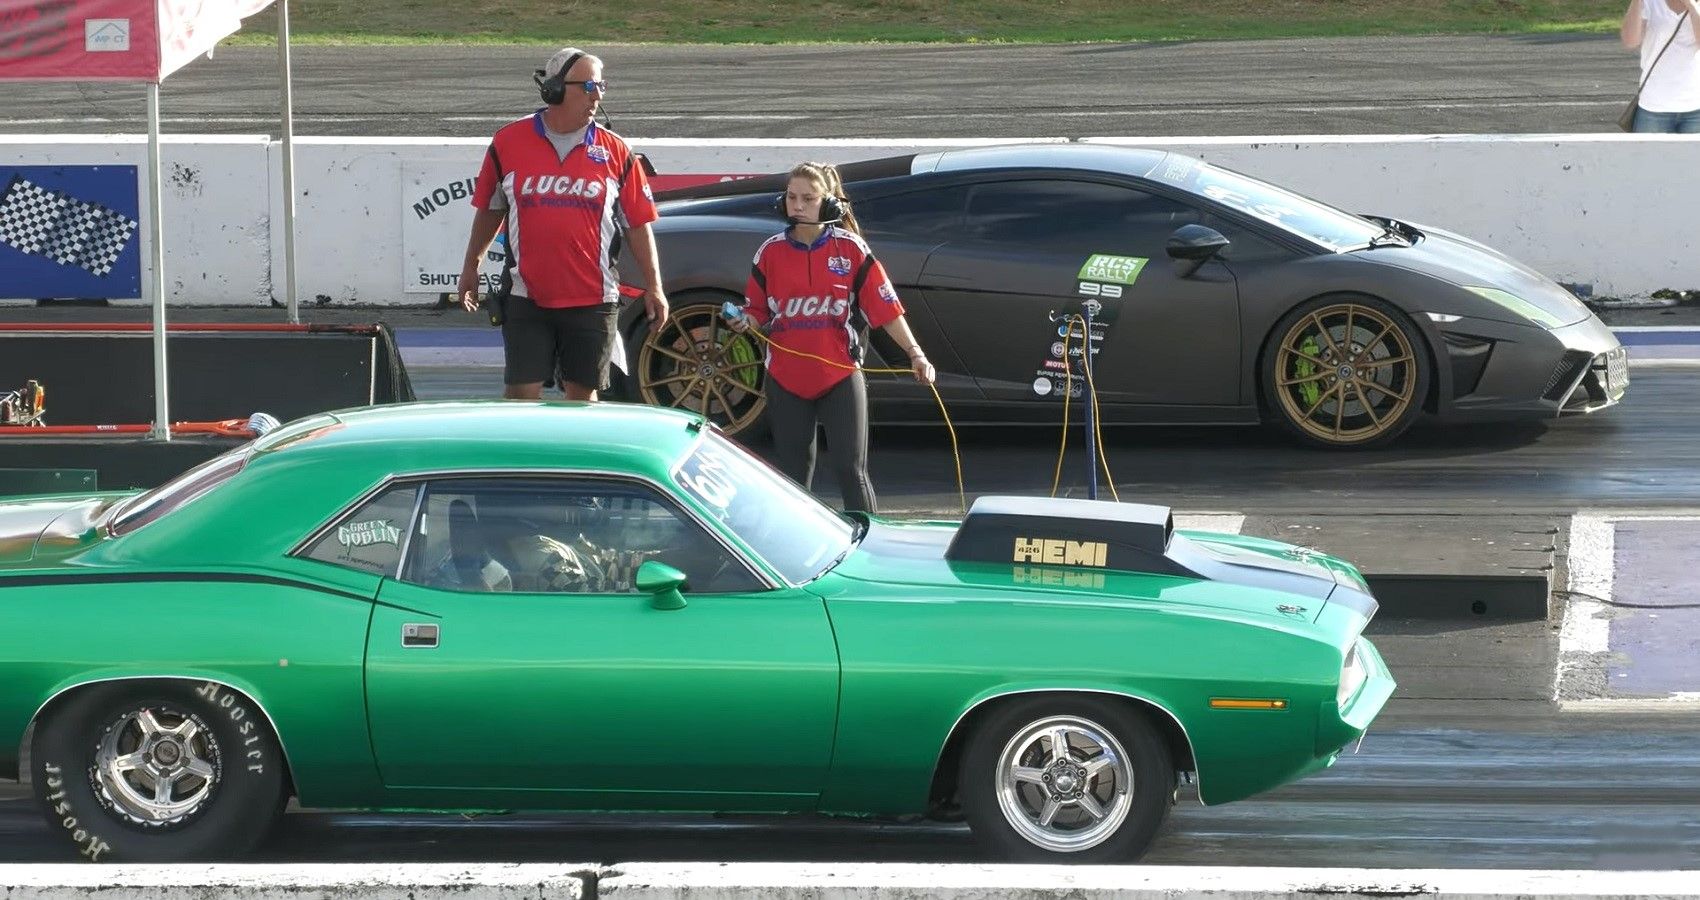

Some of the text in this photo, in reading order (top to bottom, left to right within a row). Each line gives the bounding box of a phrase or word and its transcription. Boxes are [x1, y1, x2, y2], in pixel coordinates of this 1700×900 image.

[520, 175, 604, 199] LUCAS
[1092, 256, 1139, 271] RCS
[419, 273, 487, 286] SHUTE
[1087, 266, 1132, 281] RALLY
[350, 519, 387, 532] GREEN
[338, 525, 403, 547] GOBLIN
[1013, 537, 1108, 567] HEMI
[1017, 546, 1040, 554] 426
[195, 682, 264, 775] Hoosier
[45, 761, 111, 862] Hoosier
